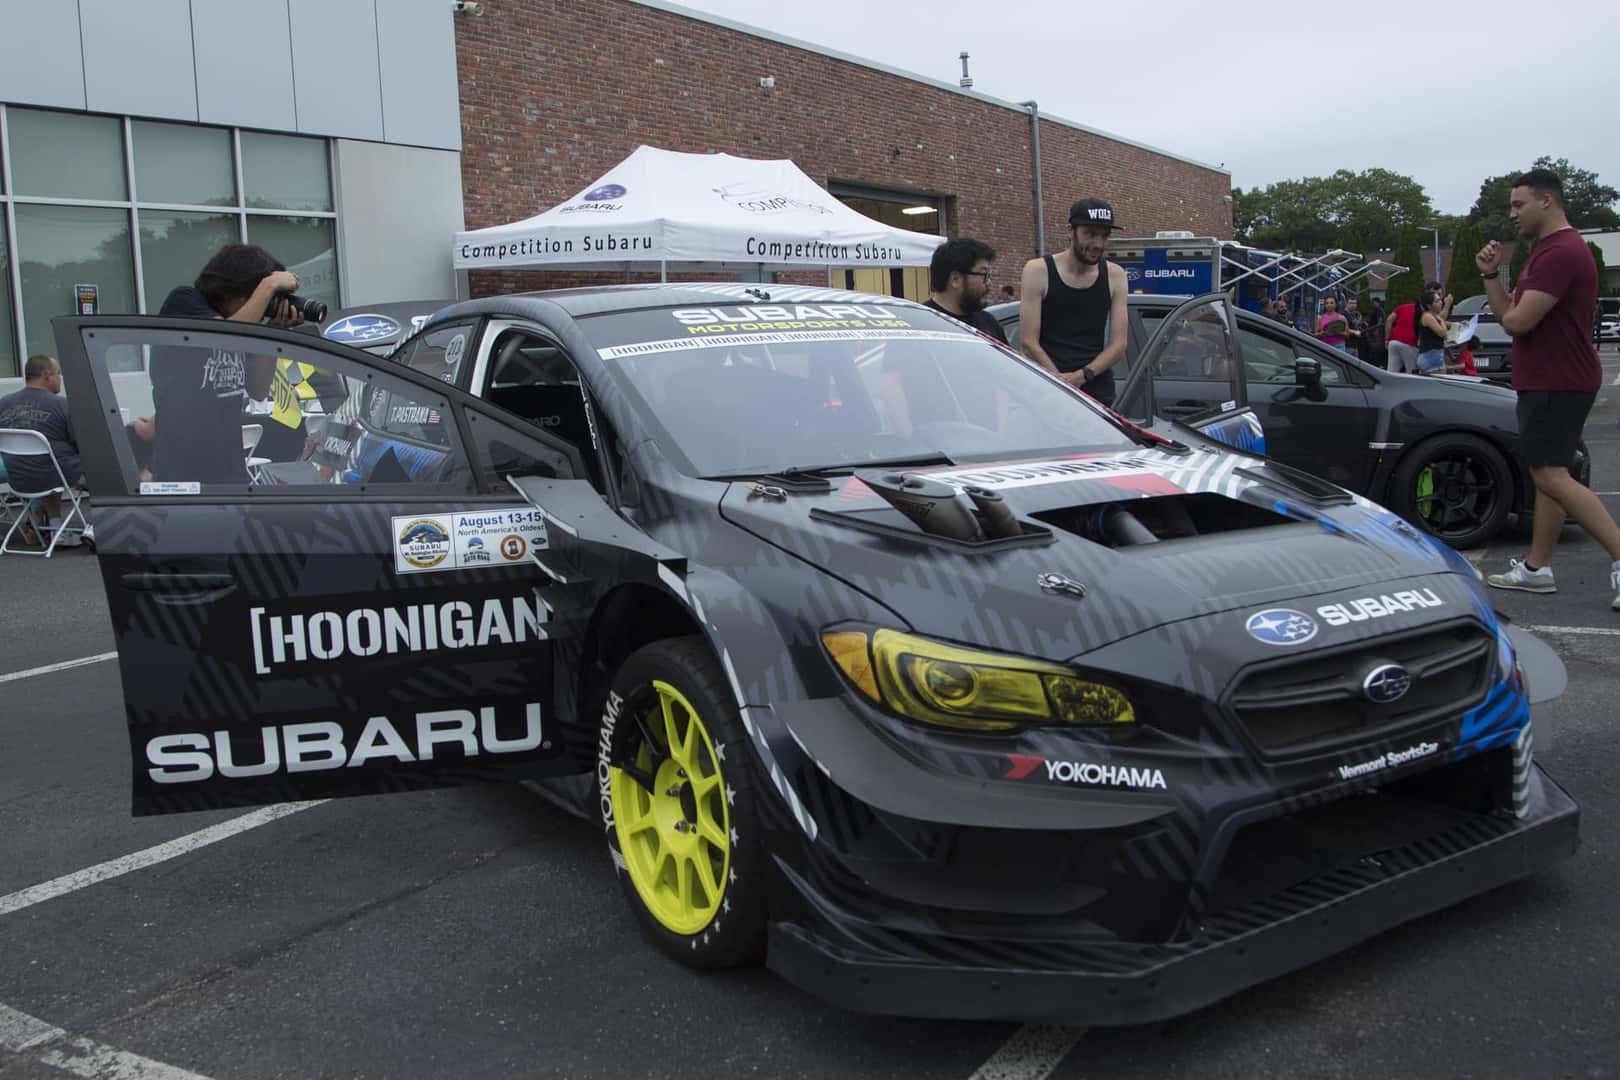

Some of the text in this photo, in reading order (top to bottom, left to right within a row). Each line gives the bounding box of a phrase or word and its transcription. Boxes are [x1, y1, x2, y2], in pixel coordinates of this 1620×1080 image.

[560, 202, 624, 214] SUBARU
[461, 234, 653, 259] Competition Subaru
[746, 237, 902, 261] Competition Subaru
[1144, 268, 1195, 278] SUBARU
[672, 304, 898, 325] SUBARU
[687, 319, 865, 334] MOTORSPORTS
[869, 319, 912, 328] USA
[458, 527, 479, 536] North
[481, 525, 518, 535] America's
[520, 524, 545, 532] Oldest
[460, 515, 503, 528] August
[1316, 588, 1443, 626] SUBARU
[145, 703, 543, 784] SUBARU
[598, 690, 624, 834] YOKOHAMA
[1338, 741, 1439, 780] Vermont SportsCar
[1044, 759, 1168, 789] YOKOHAMA
